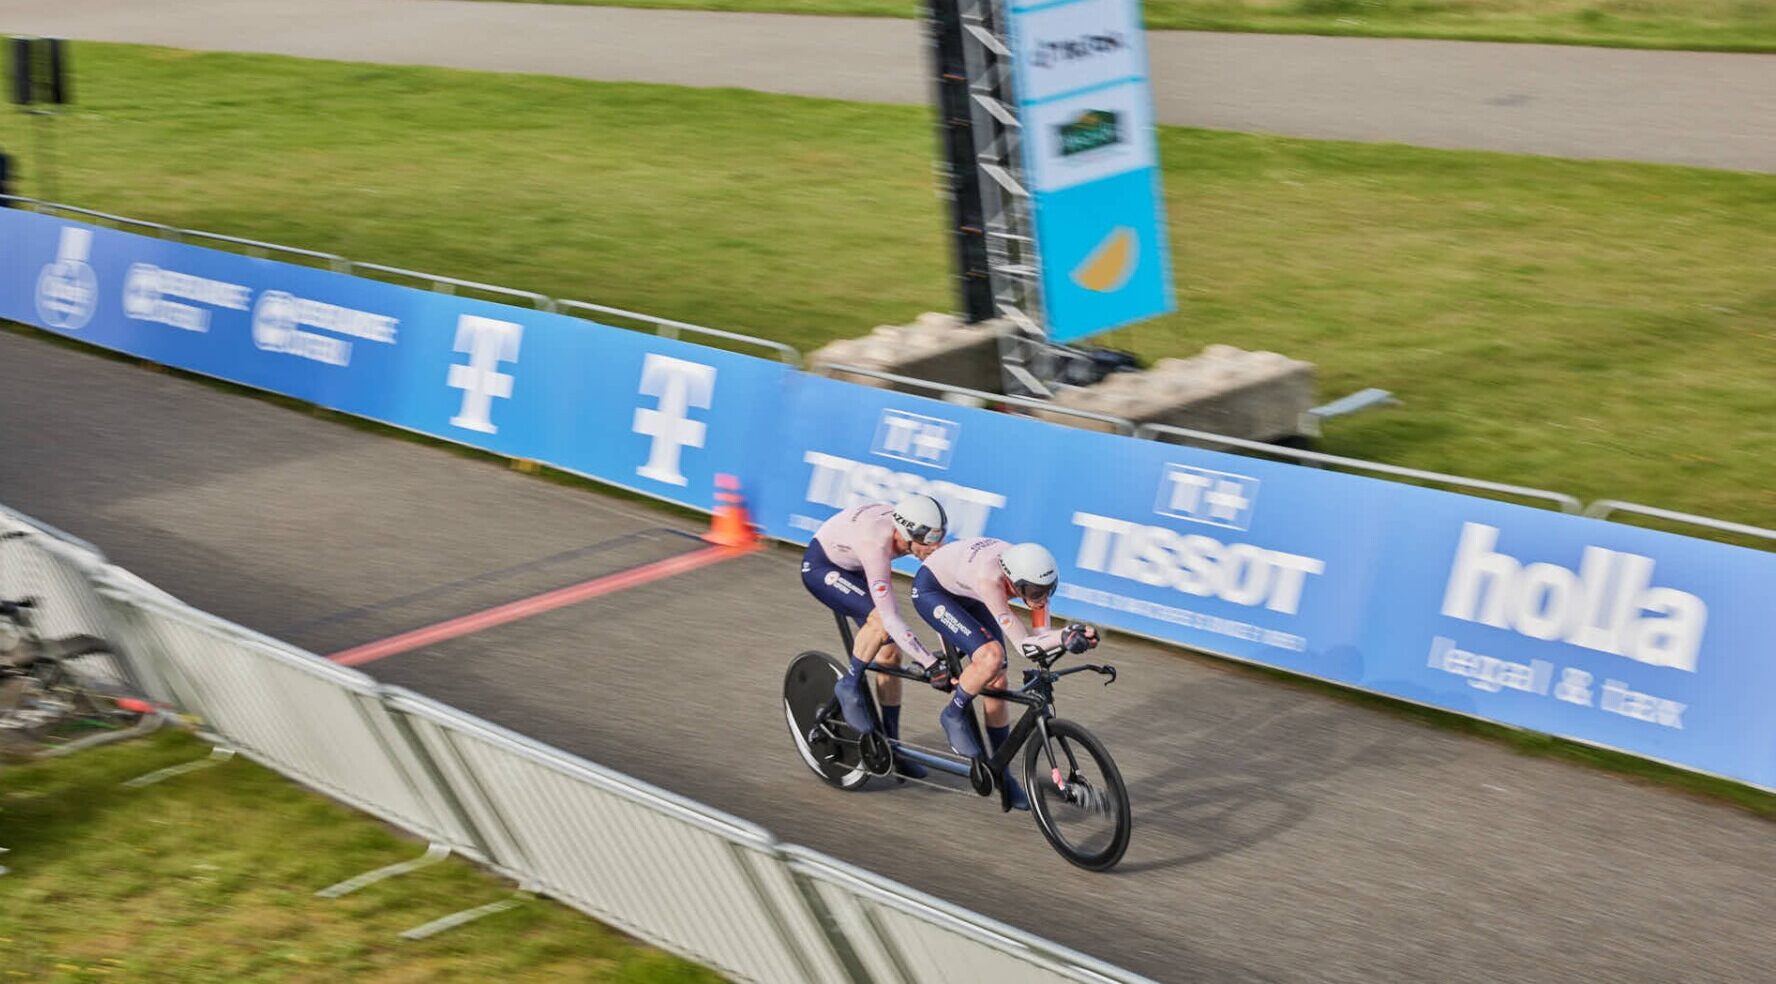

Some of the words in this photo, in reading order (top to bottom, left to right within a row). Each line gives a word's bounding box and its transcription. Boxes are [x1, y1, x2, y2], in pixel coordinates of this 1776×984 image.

[1071, 511, 1327, 616] TISSOT
[1440, 521, 1709, 674] holla
[1426, 635, 1554, 696] legal
